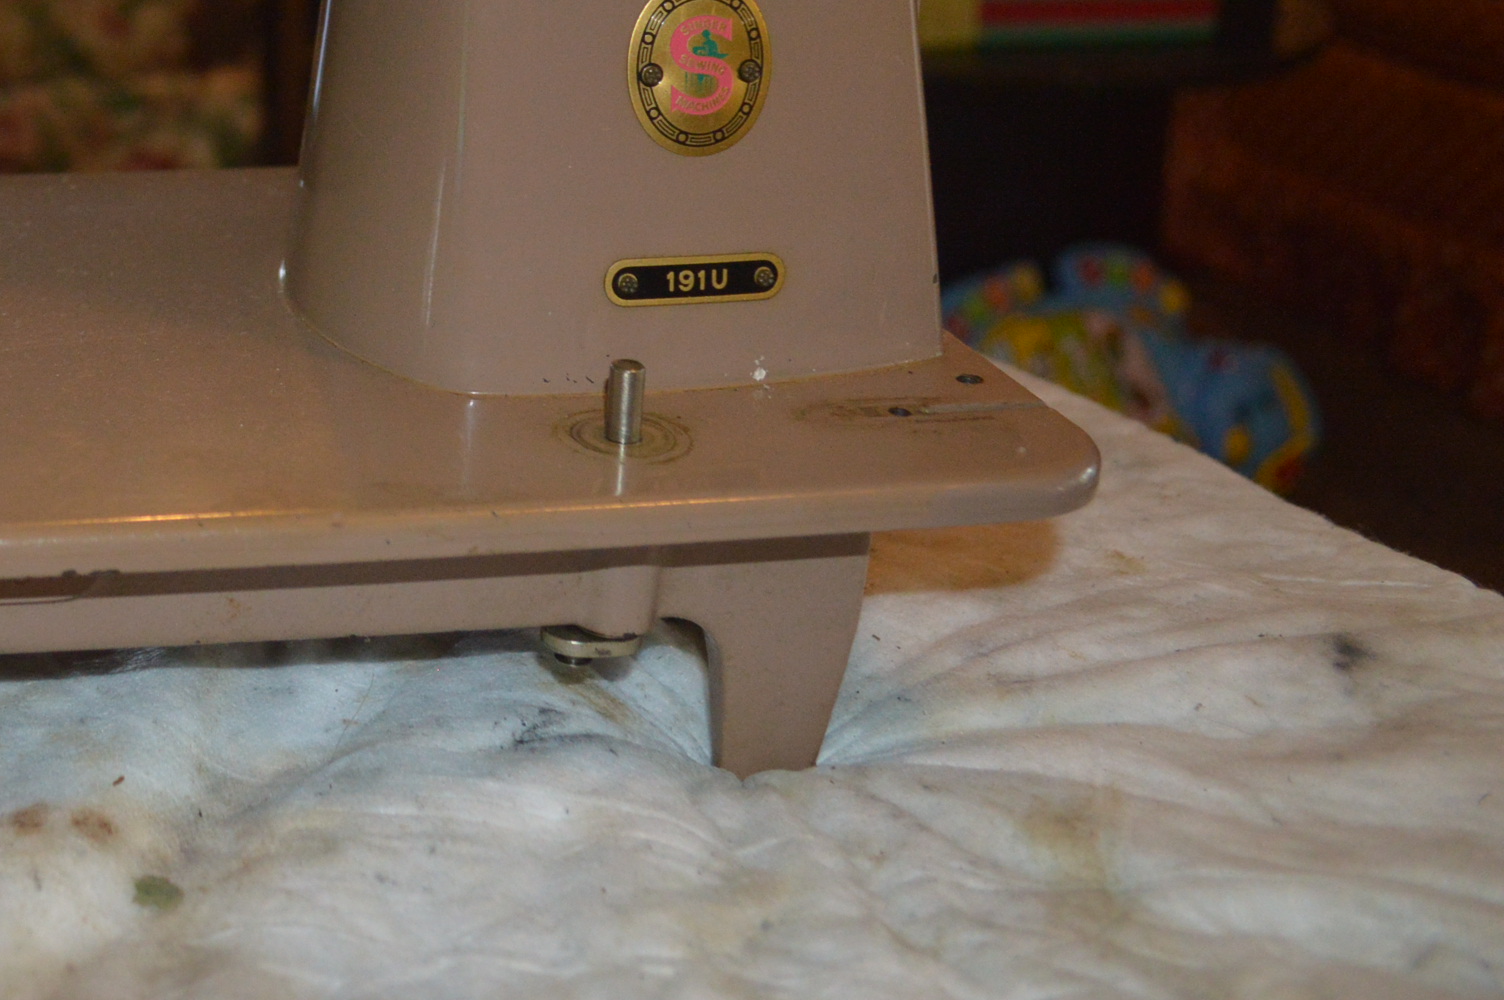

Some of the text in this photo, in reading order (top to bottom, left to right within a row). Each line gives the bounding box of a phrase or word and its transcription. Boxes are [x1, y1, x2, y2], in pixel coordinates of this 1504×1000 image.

[680, 18, 728, 36] SINGER
[679, 54, 725, 75] SEWING
[676, 87, 729, 112] MACHINES
[666, 268, 728, 292] 191U
